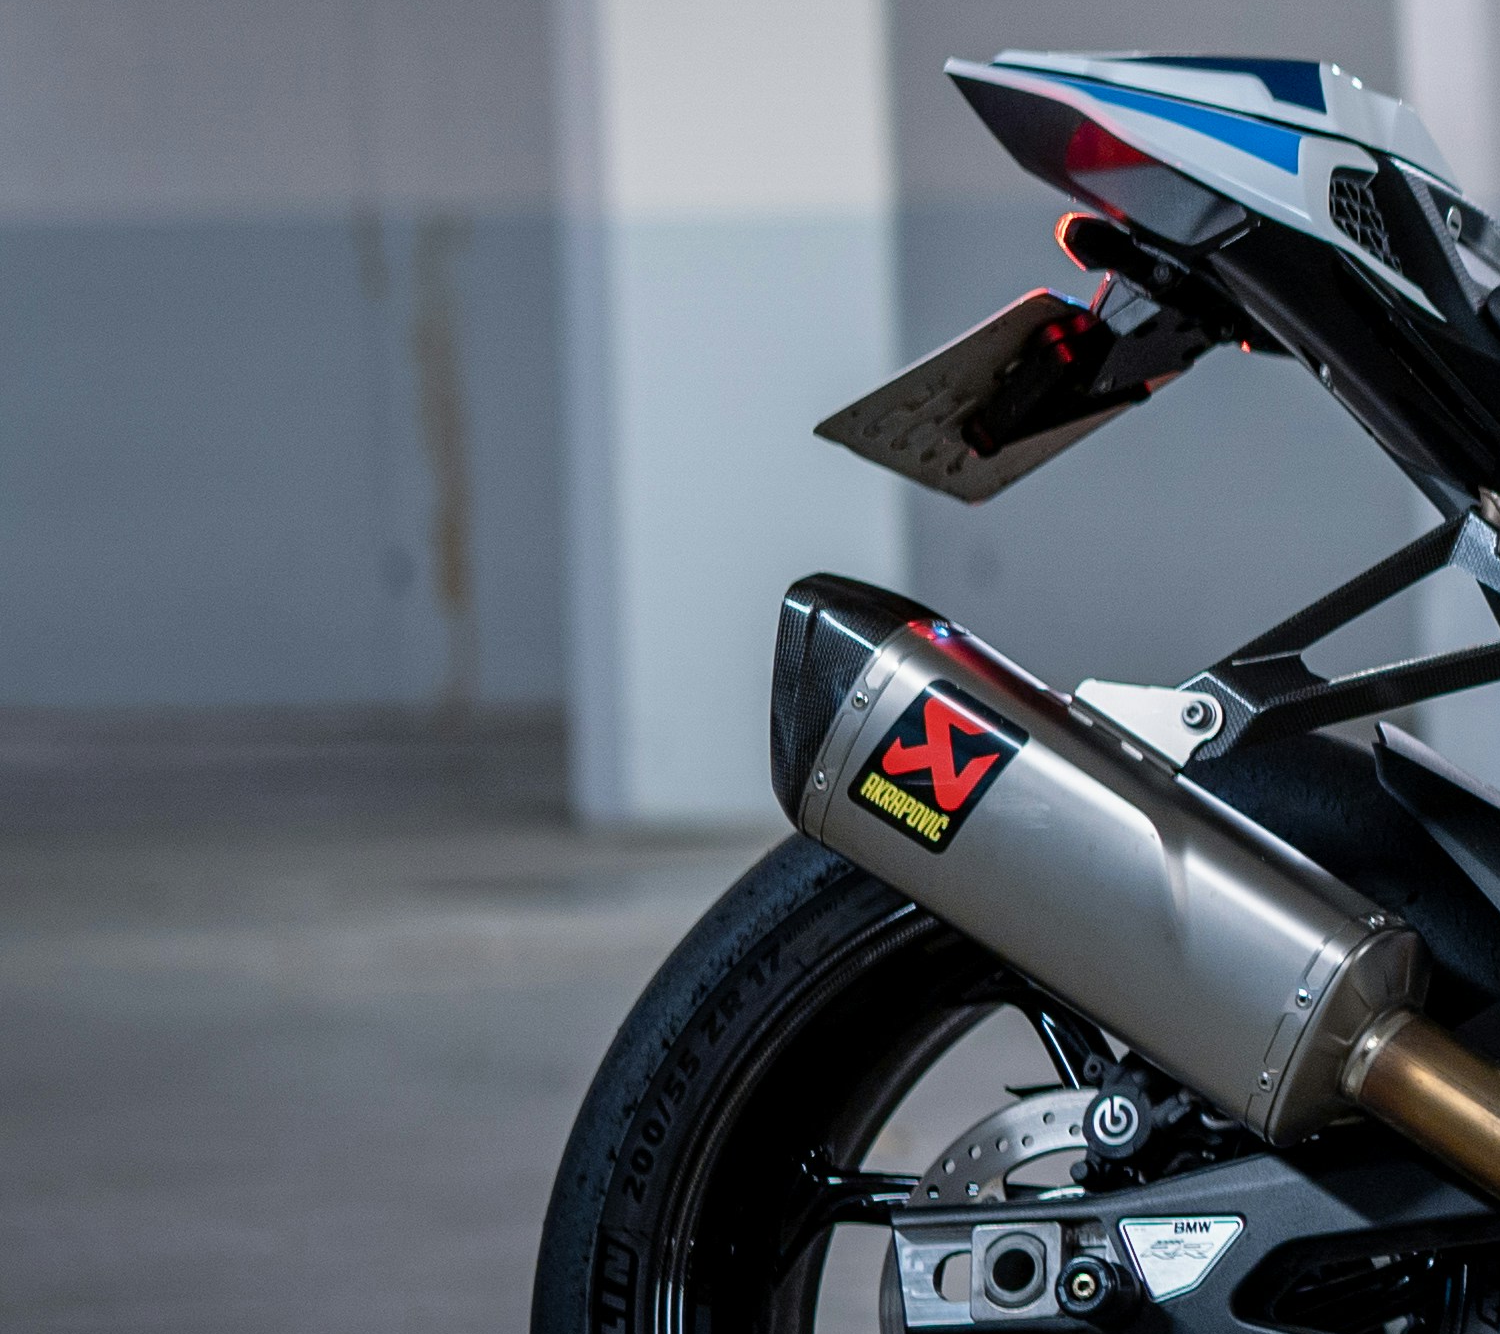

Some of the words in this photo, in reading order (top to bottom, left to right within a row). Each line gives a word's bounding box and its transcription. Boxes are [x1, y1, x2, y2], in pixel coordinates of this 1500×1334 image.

[859, 771, 951, 843] AKRAPOVIČ
[622, 1047, 700, 1204] 200/55
[702, 990, 744, 1045] ZR
[748, 944, 782, 987] 17
[1173, 1221, 1212, 1234] BMW
